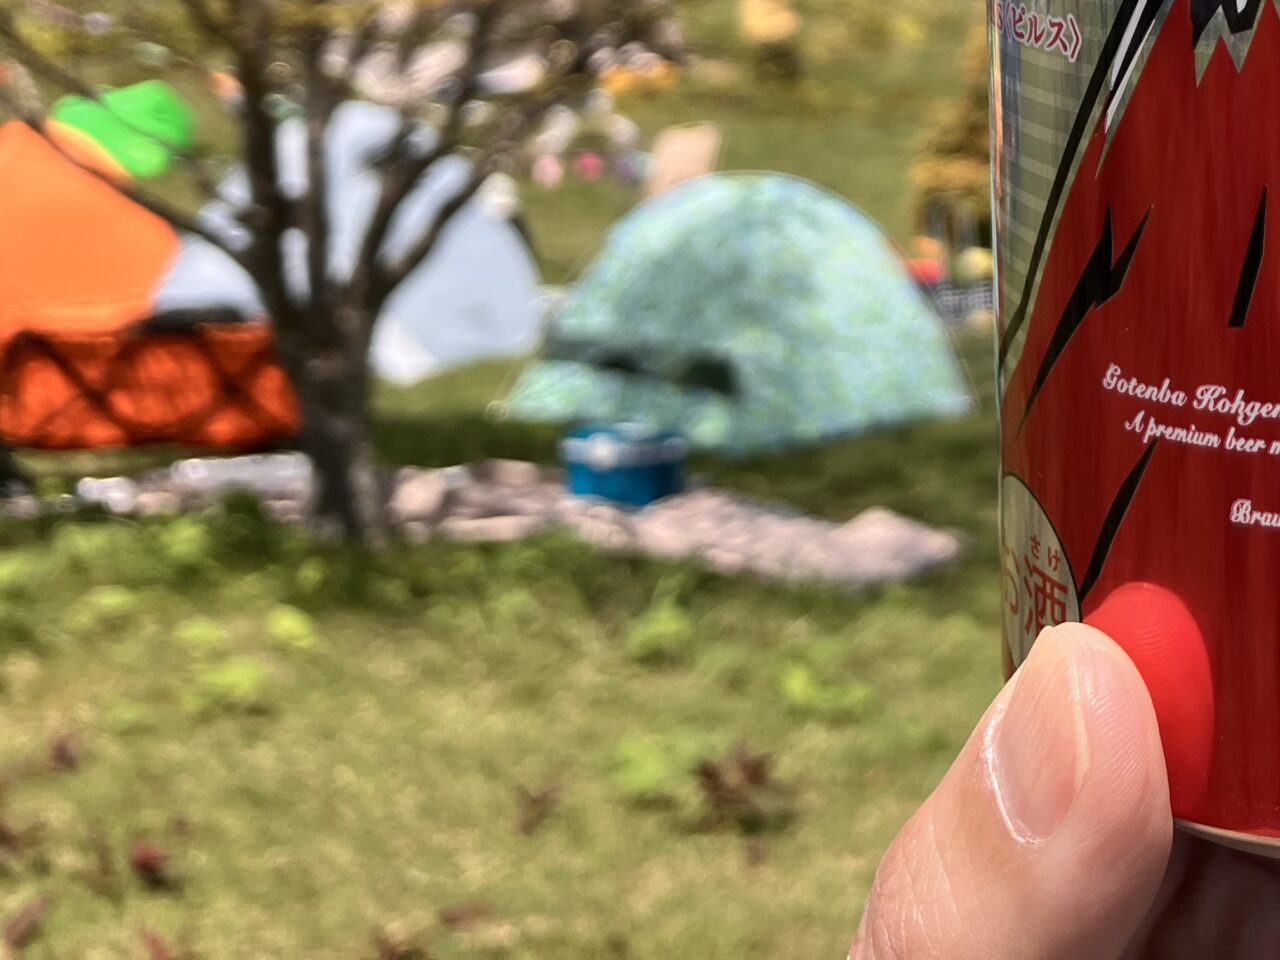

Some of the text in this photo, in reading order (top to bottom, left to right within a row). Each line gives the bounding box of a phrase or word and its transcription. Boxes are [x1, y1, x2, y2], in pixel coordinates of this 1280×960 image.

[1102, 362, 1188, 407] Gotenba
[1124, 409, 1145, 433] A
[1142, 416, 1222, 448] premium
[1225, 426, 1266, 453] beer
[1030, 533, 1061, 571] さけ
